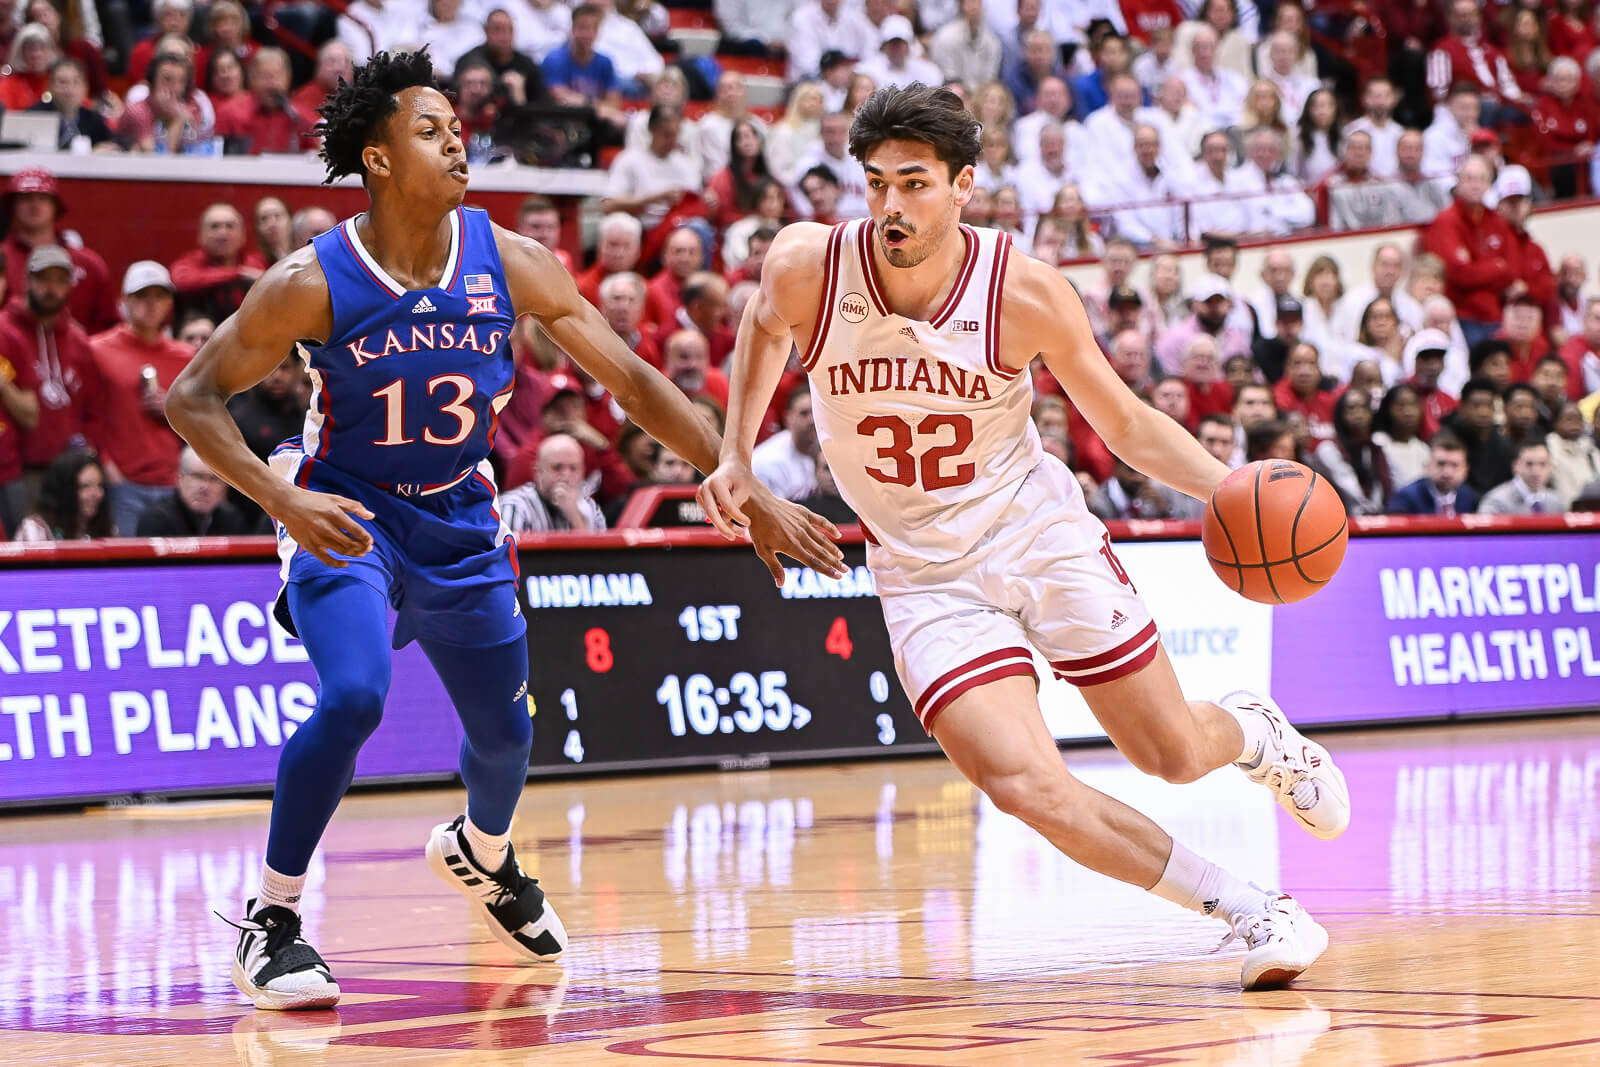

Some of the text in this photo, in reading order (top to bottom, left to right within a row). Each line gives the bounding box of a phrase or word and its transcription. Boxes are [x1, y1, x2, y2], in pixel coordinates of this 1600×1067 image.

[411, 306, 437, 314] adidas
[841, 302, 866, 316] RMK
[346, 323, 504, 368] KANSAS
[828, 357, 992, 400] INDIANA
[371, 372, 478, 446] 13
[857, 414, 976, 492] 32
[396, 483, 420, 497] KU
[526, 573, 653, 608] INDIANA
[780, 565, 874, 599] KANSA
[1379, 562, 1600, 620] MARKETPL
[678, 605, 741, 642] 1ST
[825, 616, 854, 660] 4
[1160, 625, 1240, 656] urce
[584, 627, 614, 673] 8
[1389, 627, 1548, 687] HEALTH
[560, 687, 579, 721] 1
[656, 670, 794, 736] 16:35
[869, 670, 890, 703] 0
[0, 681, 318, 761] TH PLANS
[875, 712, 896, 745] 3
[563, 728, 585, 763] 4
